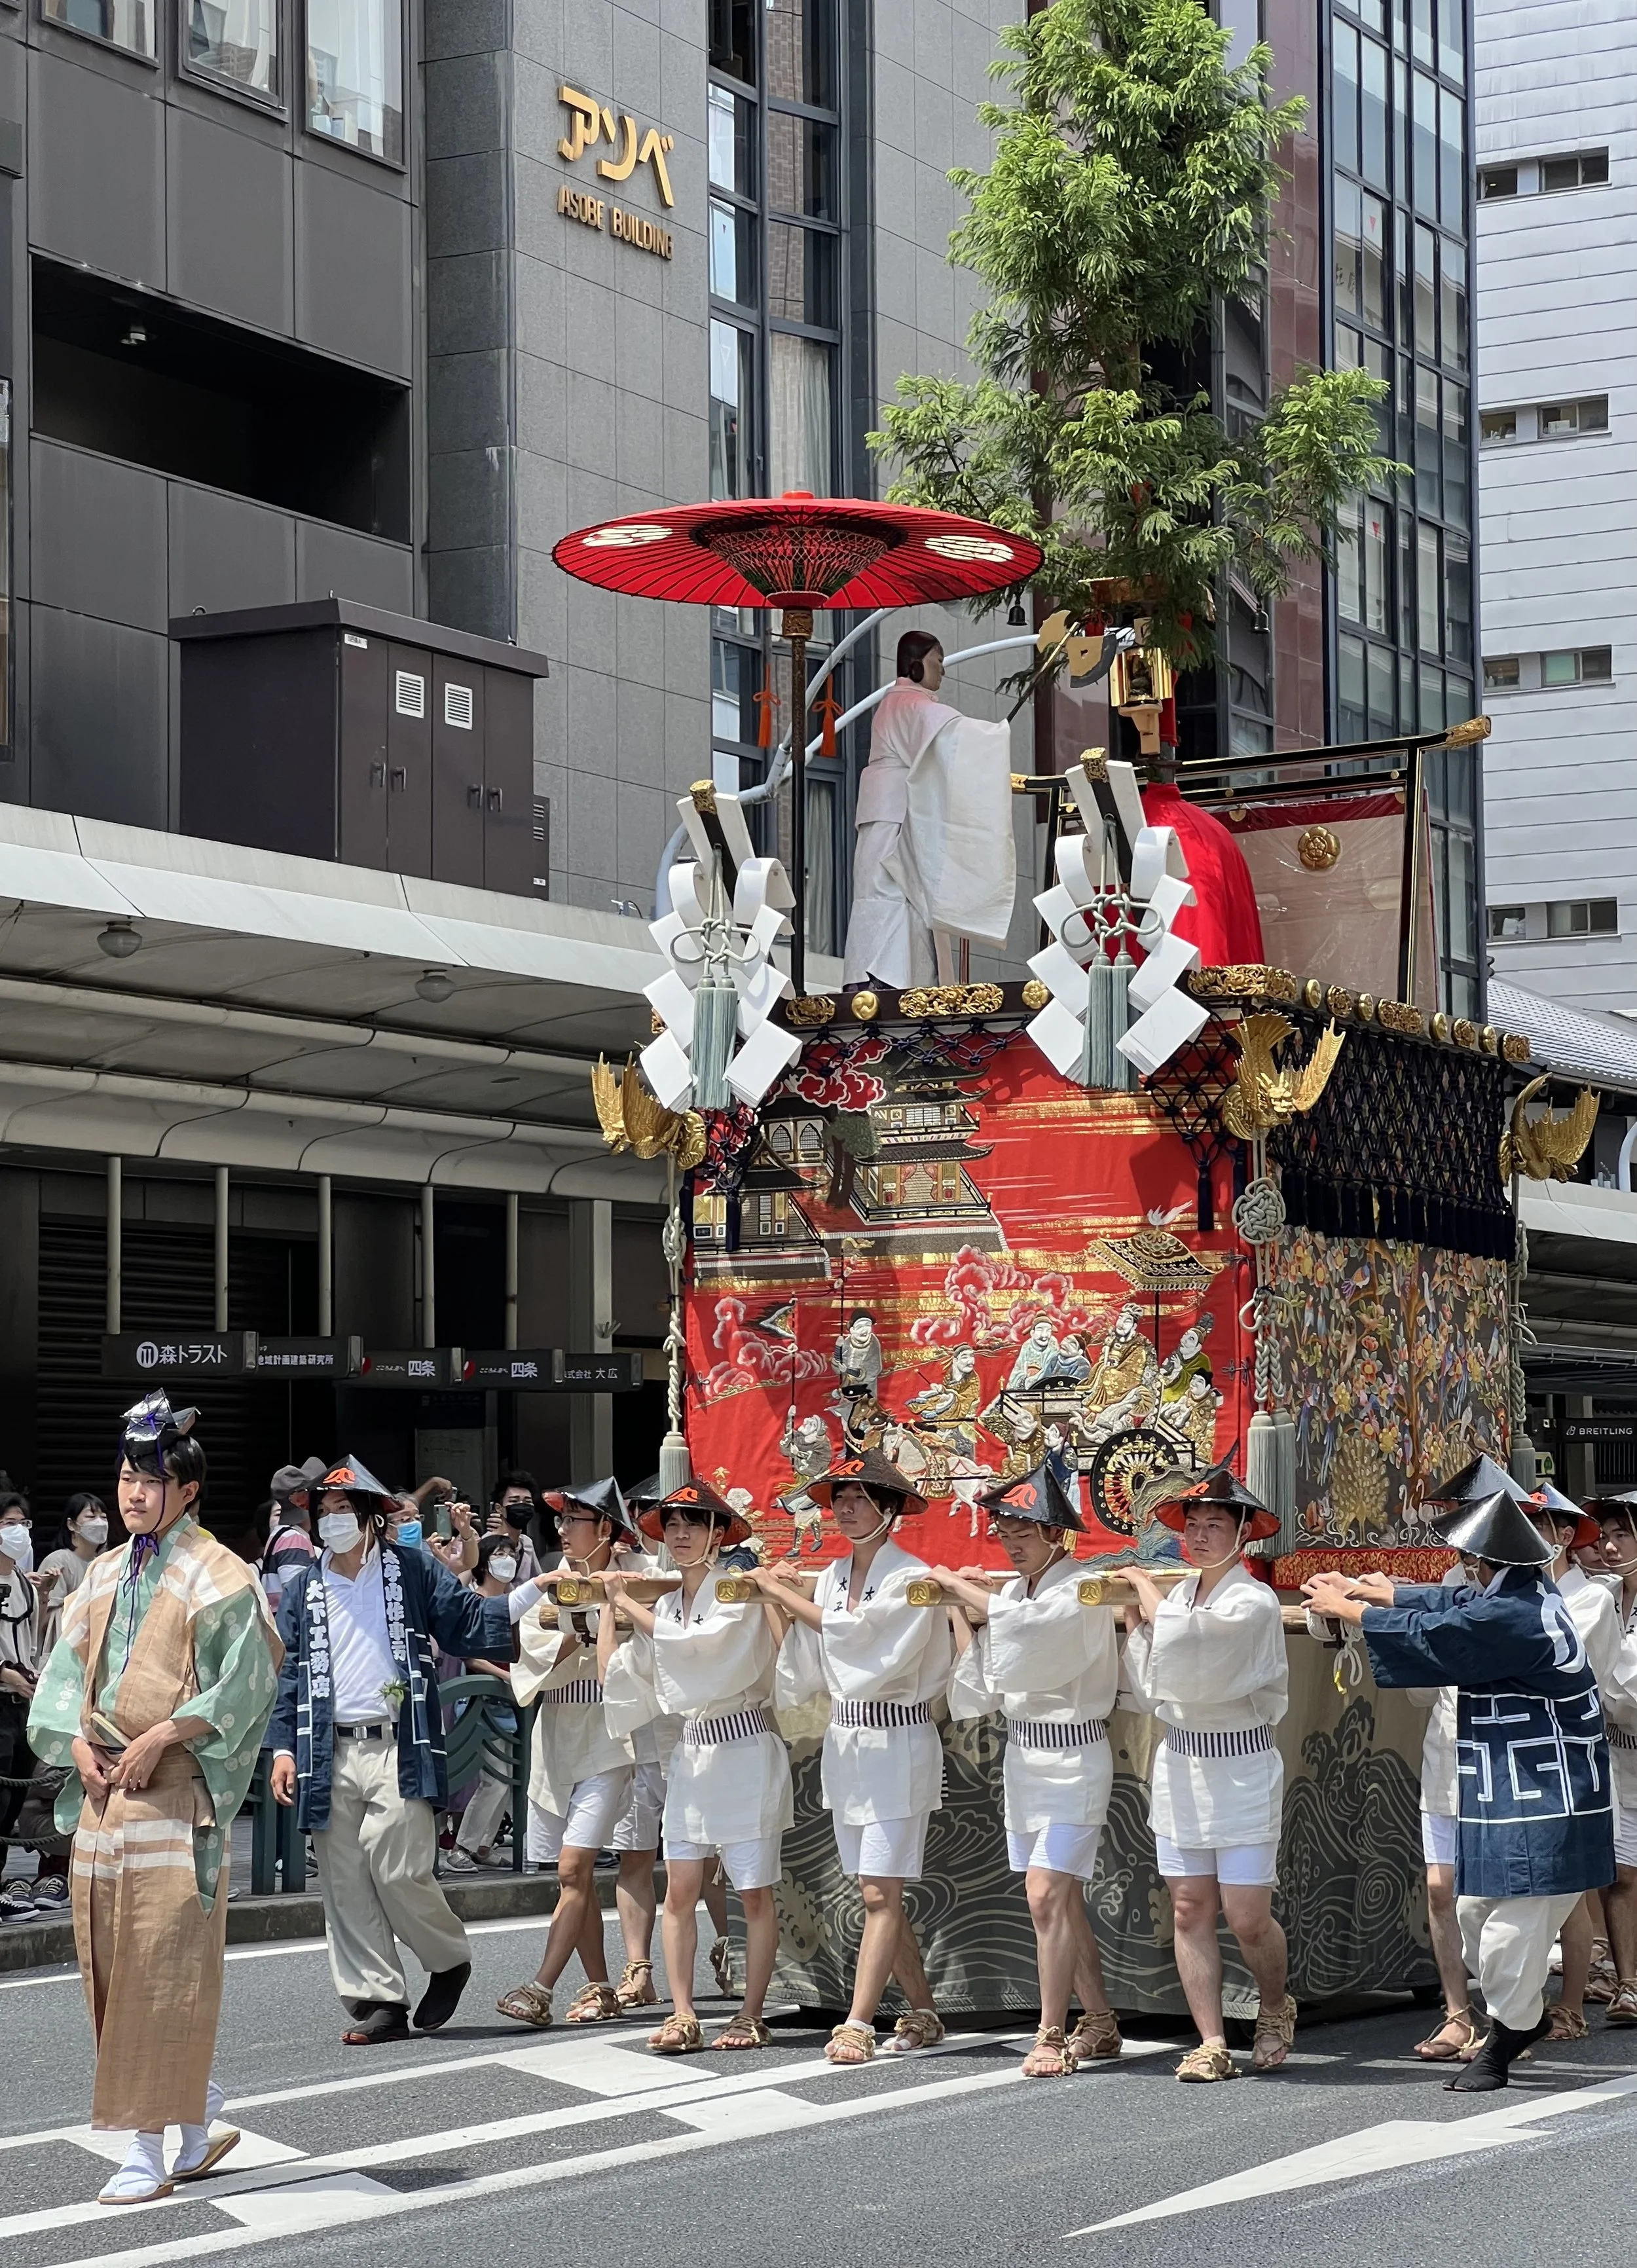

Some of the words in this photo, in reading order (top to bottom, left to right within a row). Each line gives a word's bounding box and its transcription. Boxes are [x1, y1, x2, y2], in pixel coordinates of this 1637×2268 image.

[558, 185, 605, 230] ASOBE
[610, 207, 674, 260] BUILDING
[158, 1345, 228, 1364] 森トラスト
[409, 1360, 435, 1377] 四条
[511, 1362, 538, 1378] 四条
[595, 1368, 618, 1379] 大広
[306, 1580, 330, 1698] 大下工務店
